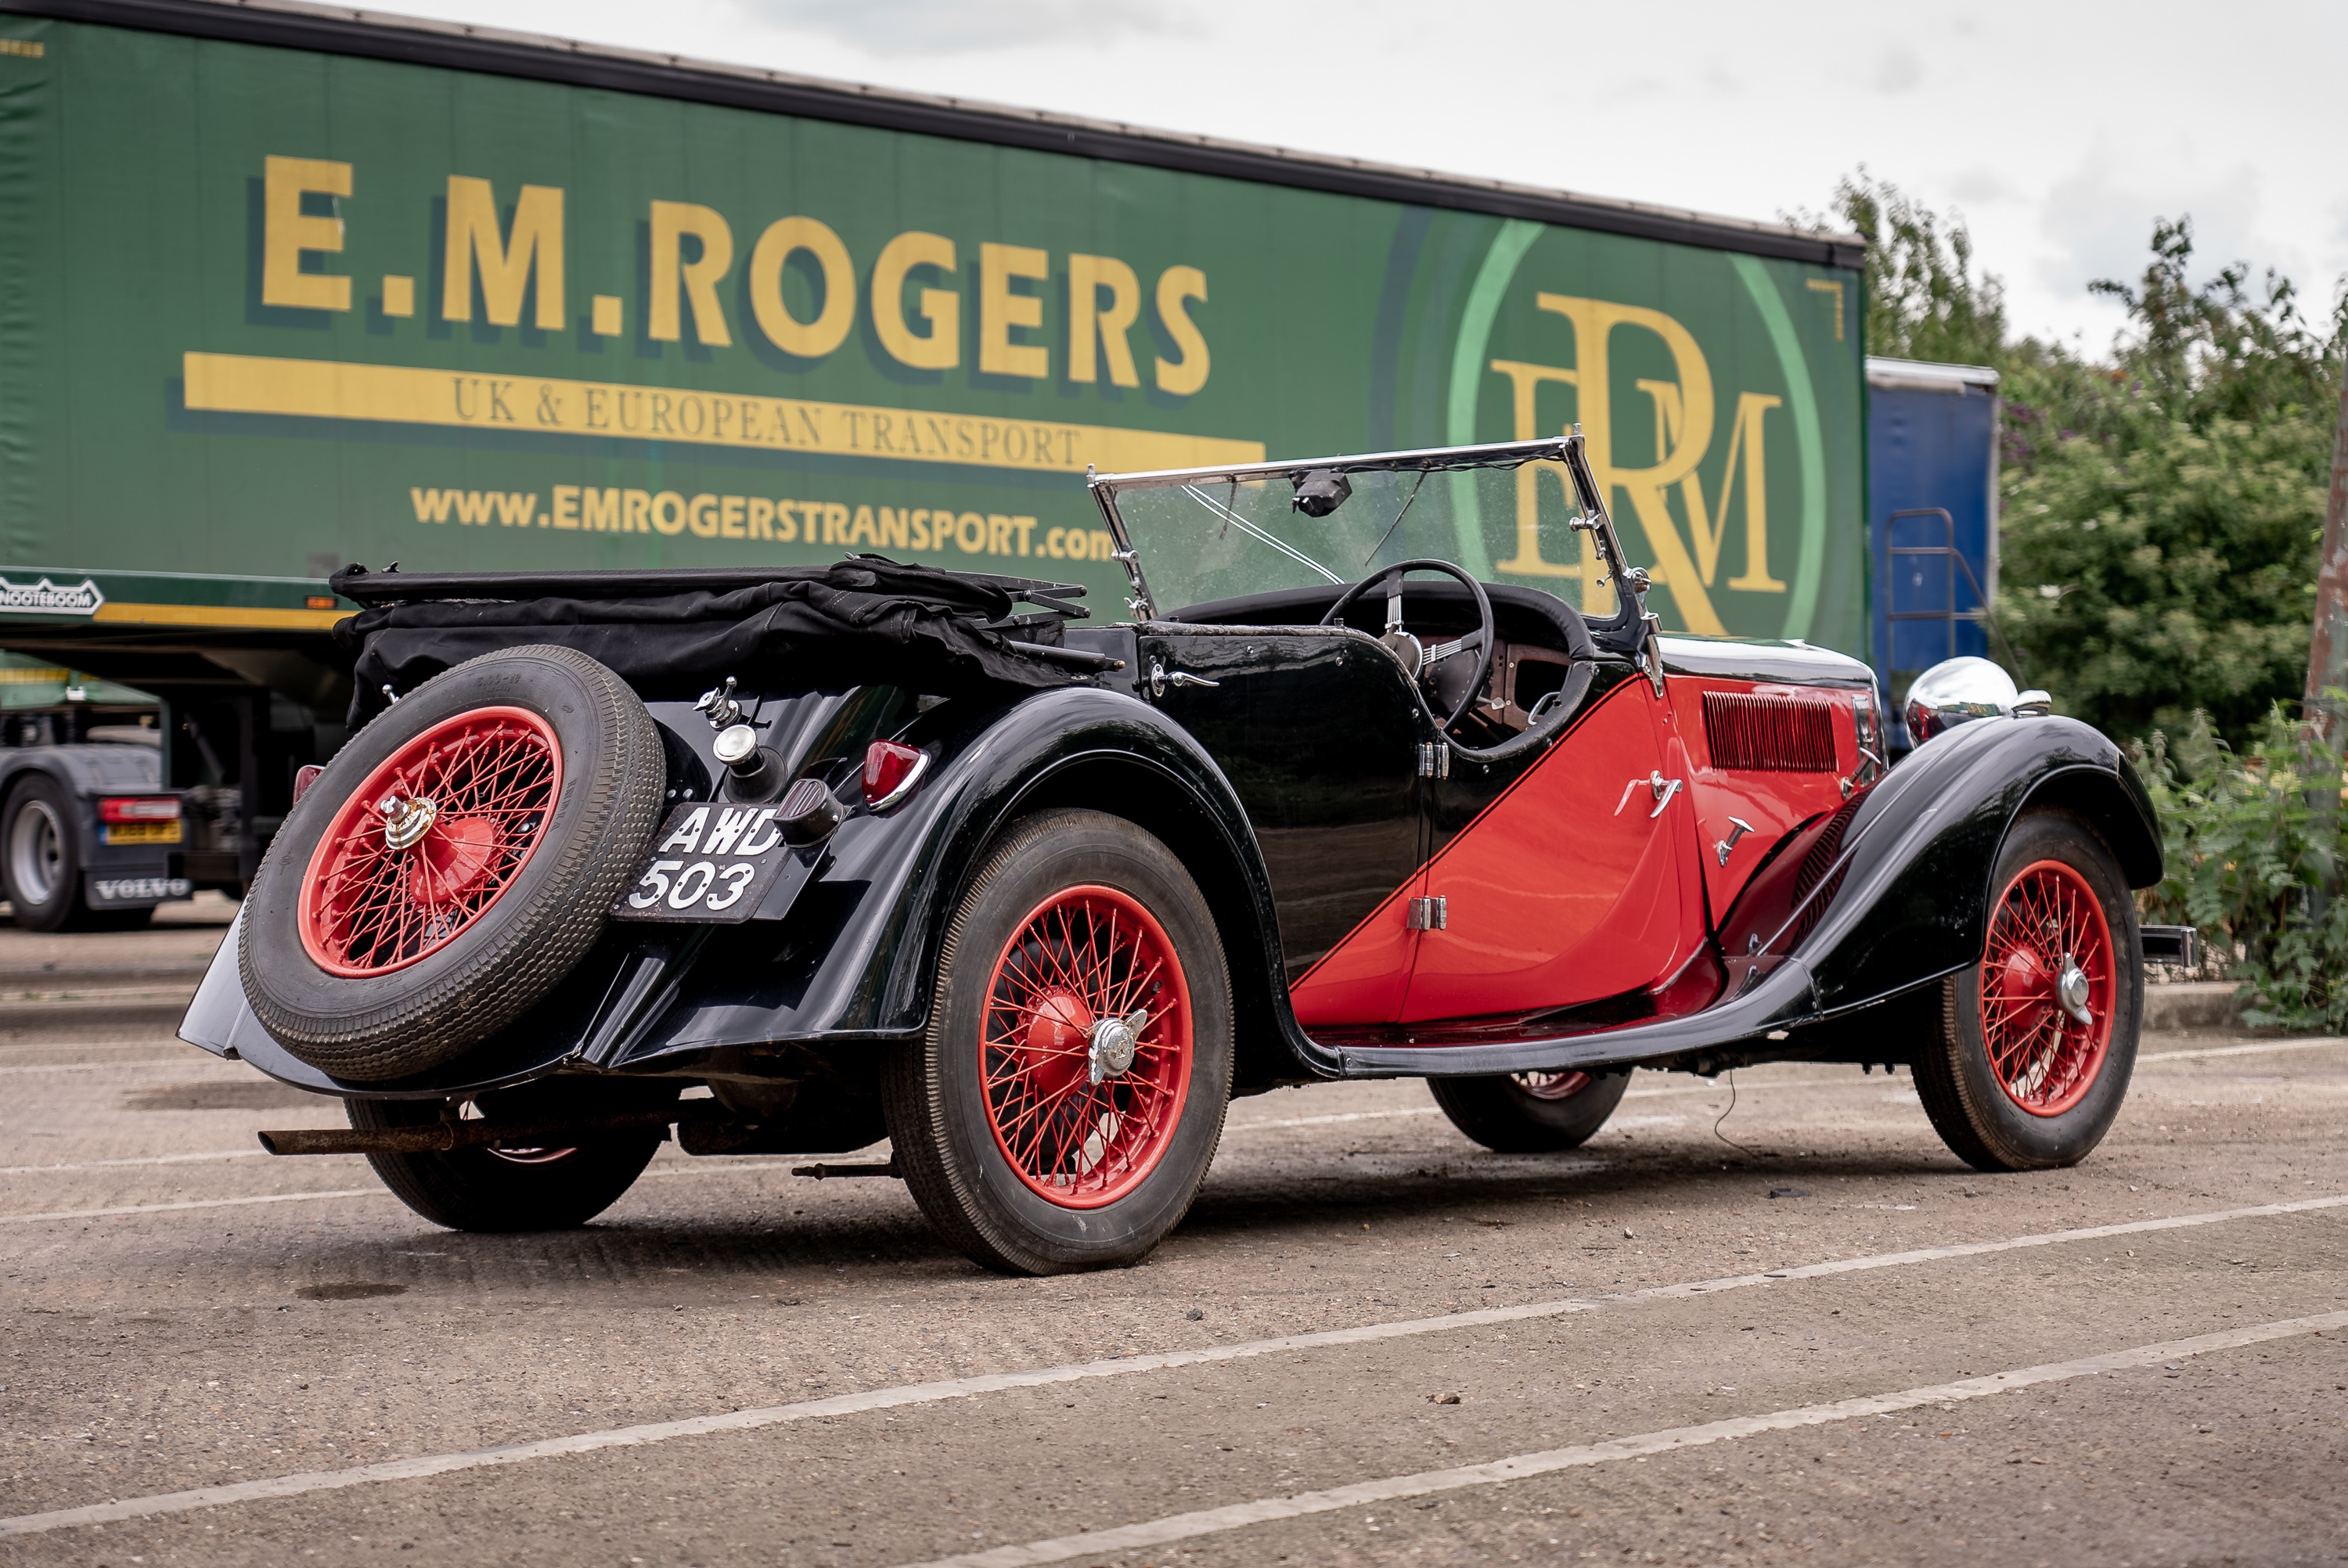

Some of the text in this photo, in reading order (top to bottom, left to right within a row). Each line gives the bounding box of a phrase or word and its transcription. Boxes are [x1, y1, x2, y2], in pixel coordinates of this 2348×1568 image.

[452, 376, 1082, 466] UK & EUROPEAN TRANSPORT
[0, 590, 91, 607] NOOTEBOOM
[658, 807, 784, 856] AWD
[95, 878, 190, 900] VOLVO
[628, 860, 755, 911] 503
